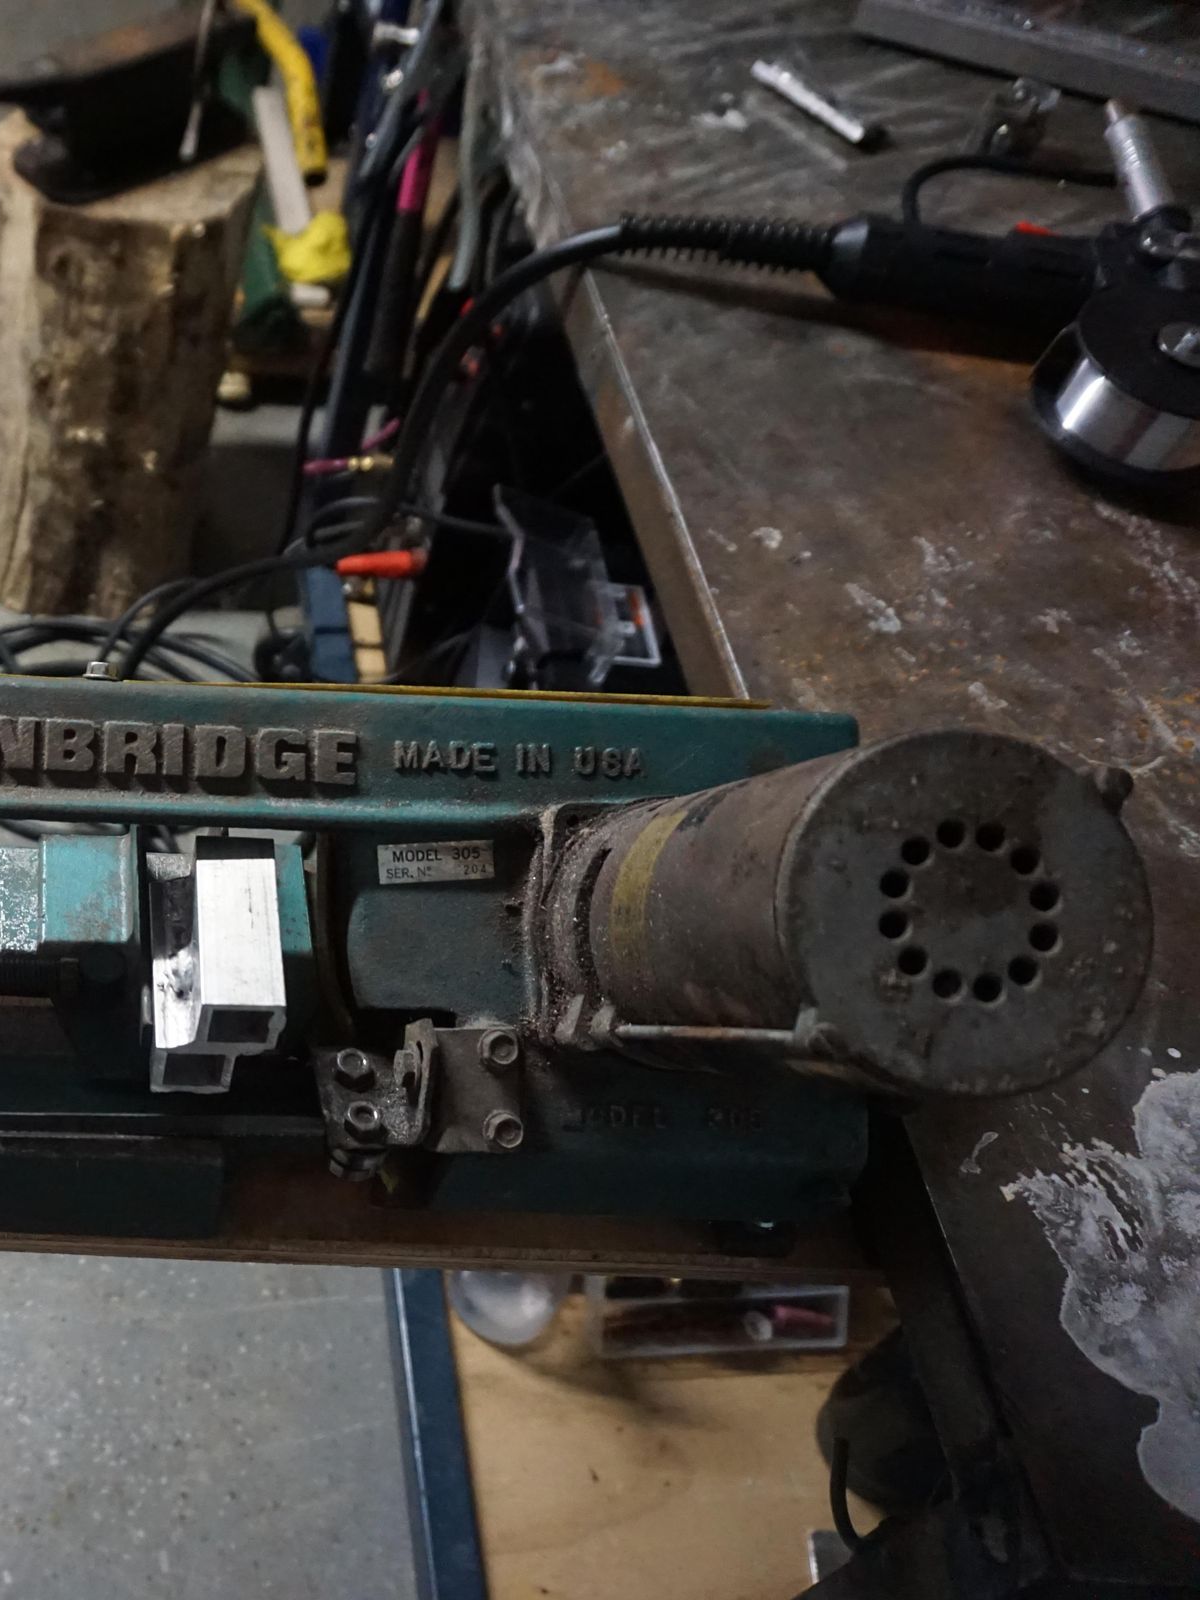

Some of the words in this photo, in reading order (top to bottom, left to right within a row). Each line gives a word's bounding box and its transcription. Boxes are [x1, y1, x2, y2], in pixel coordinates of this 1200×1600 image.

[394, 739, 497, 774] MADE
[515, 742, 552, 774] IN
[573, 746, 645, 778] USA
[392, 849, 442, 863] MODEL
[452, 847, 481, 860] 305
[386, 867, 414, 880] SER.
[464, 864, 487, 876] 204
